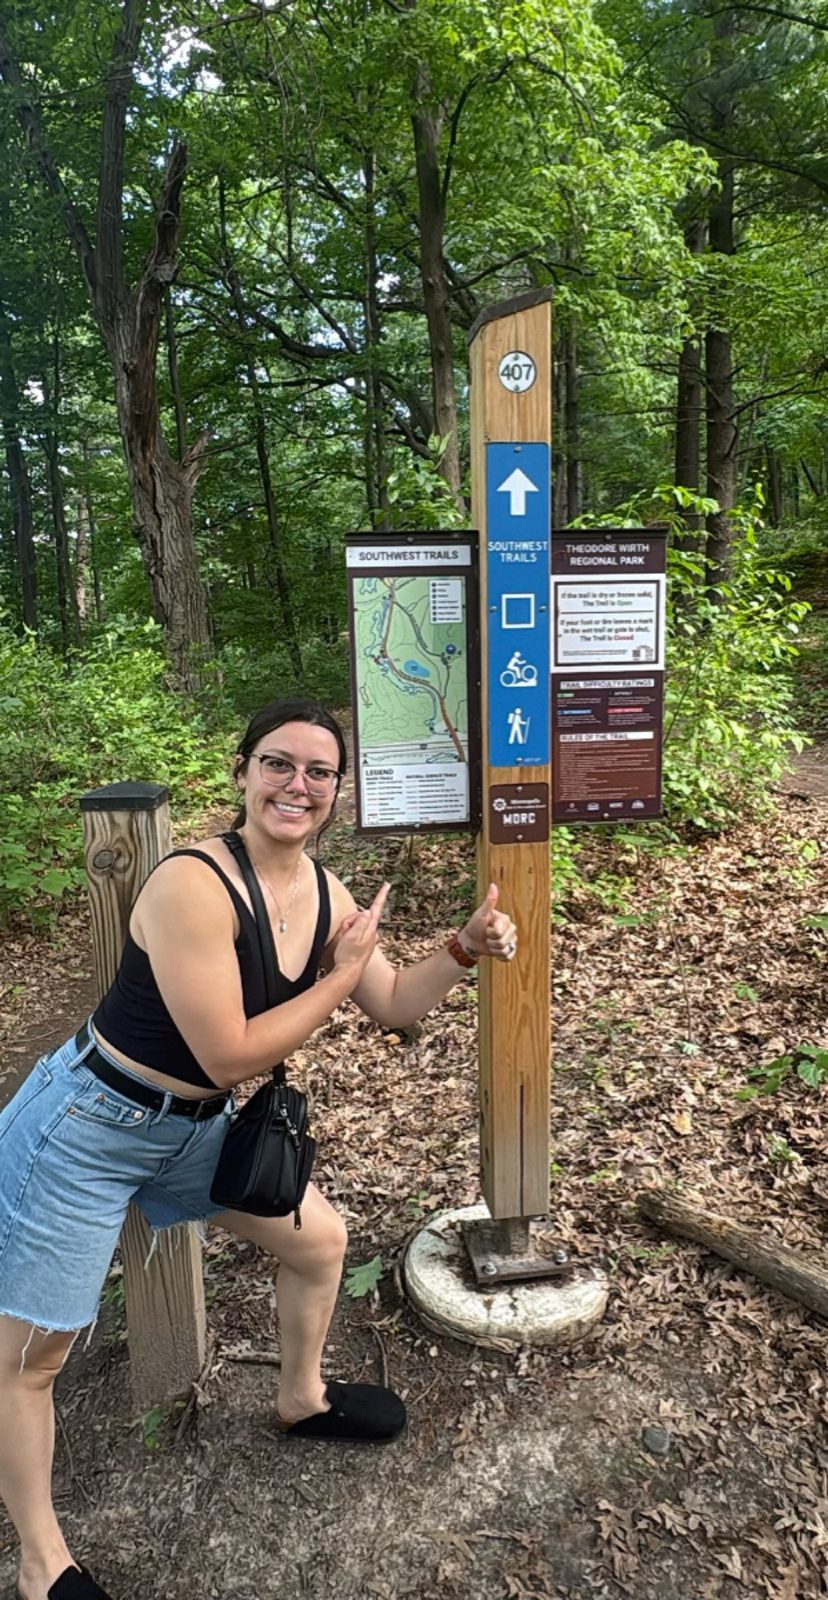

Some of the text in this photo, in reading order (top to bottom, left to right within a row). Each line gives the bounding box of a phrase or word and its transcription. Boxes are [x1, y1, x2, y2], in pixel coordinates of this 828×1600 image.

[500, 364, 532, 381] 407
[488, 541, 548, 551] SOUTHWEST
[566, 544, 650, 553] THEODORE WIRTH
[359, 550, 459, 561] SOUTHWEST TRAILS
[500, 553, 537, 562] TRAILS
[570, 556, 645, 566] REGIONAL PARK
[504, 812, 536, 824] MORC
